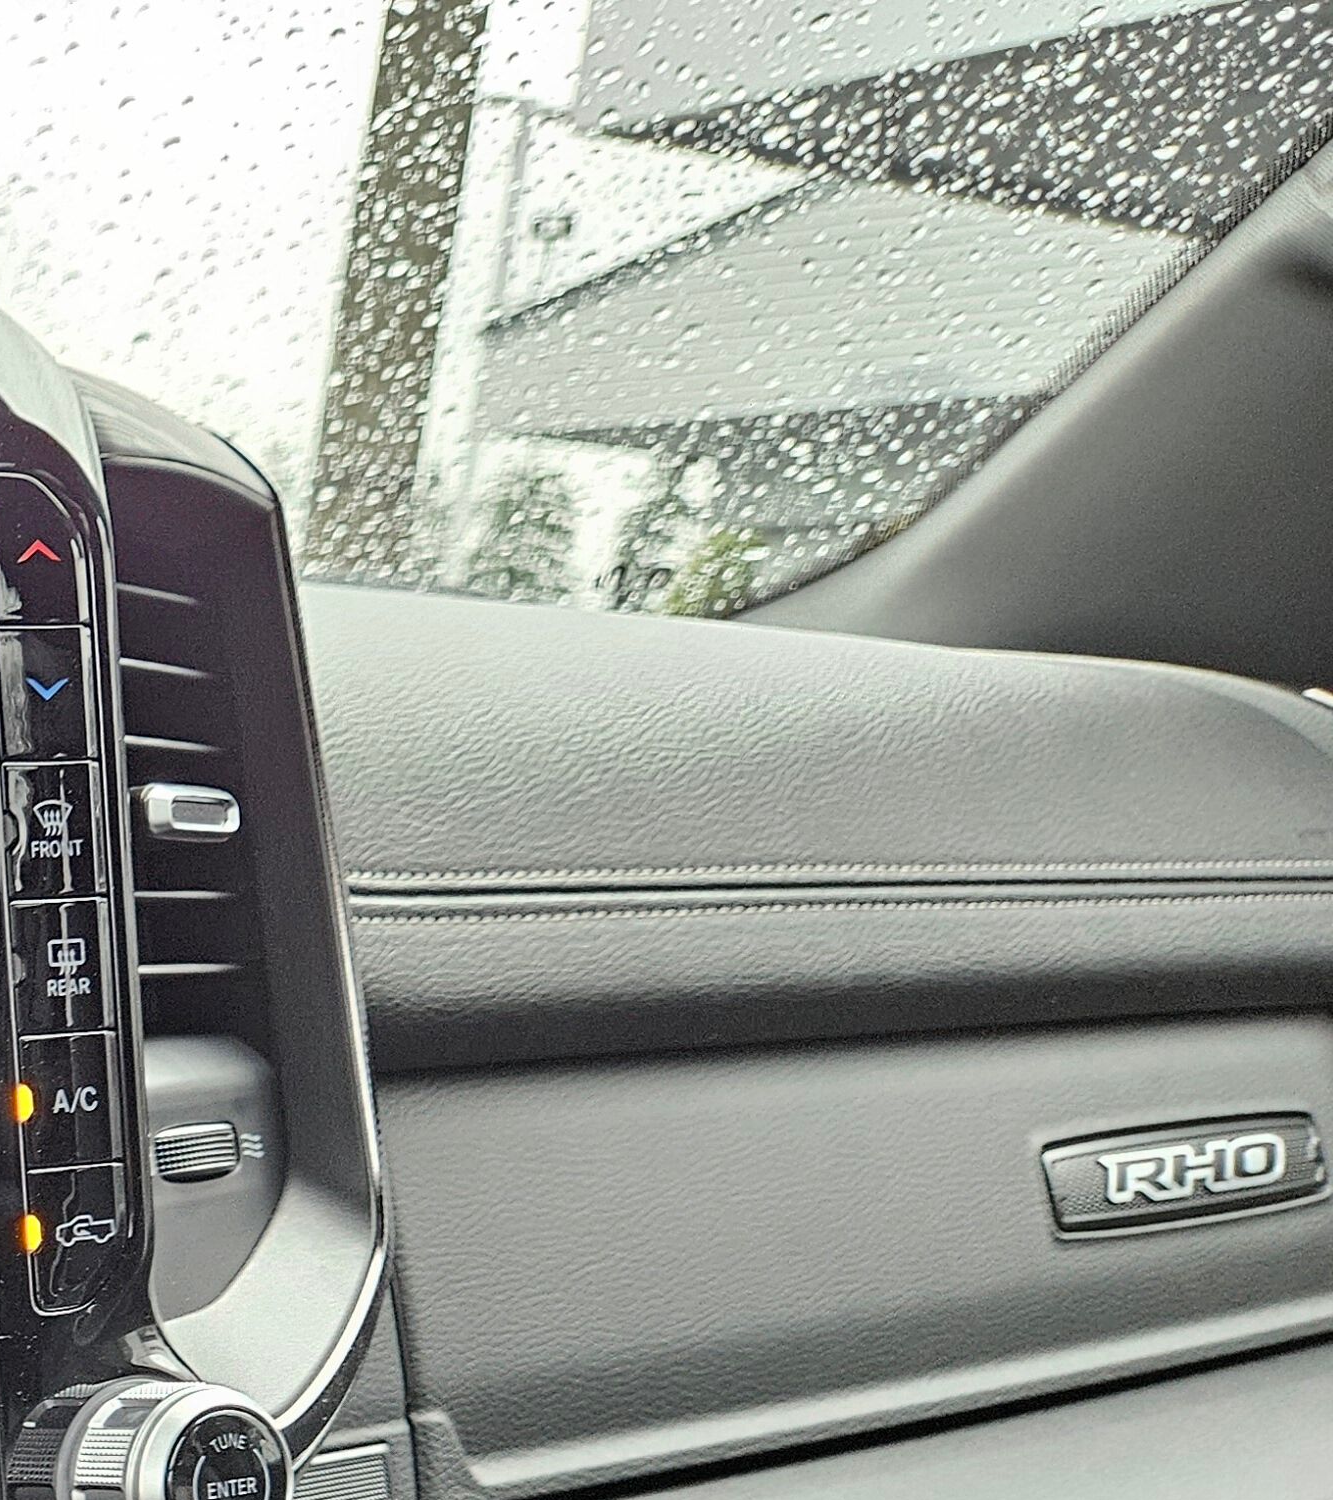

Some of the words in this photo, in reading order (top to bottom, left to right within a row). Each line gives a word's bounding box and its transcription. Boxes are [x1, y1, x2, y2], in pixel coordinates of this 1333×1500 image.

[31, 839, 83, 858] FRONT
[47, 977, 91, 997] REAR
[53, 1086, 98, 1114] A/C
[1097, 1133, 1284, 1204] RHO
[209, 1432, 248, 1453] TUNE
[206, 1477, 257, 1500] ENTER
